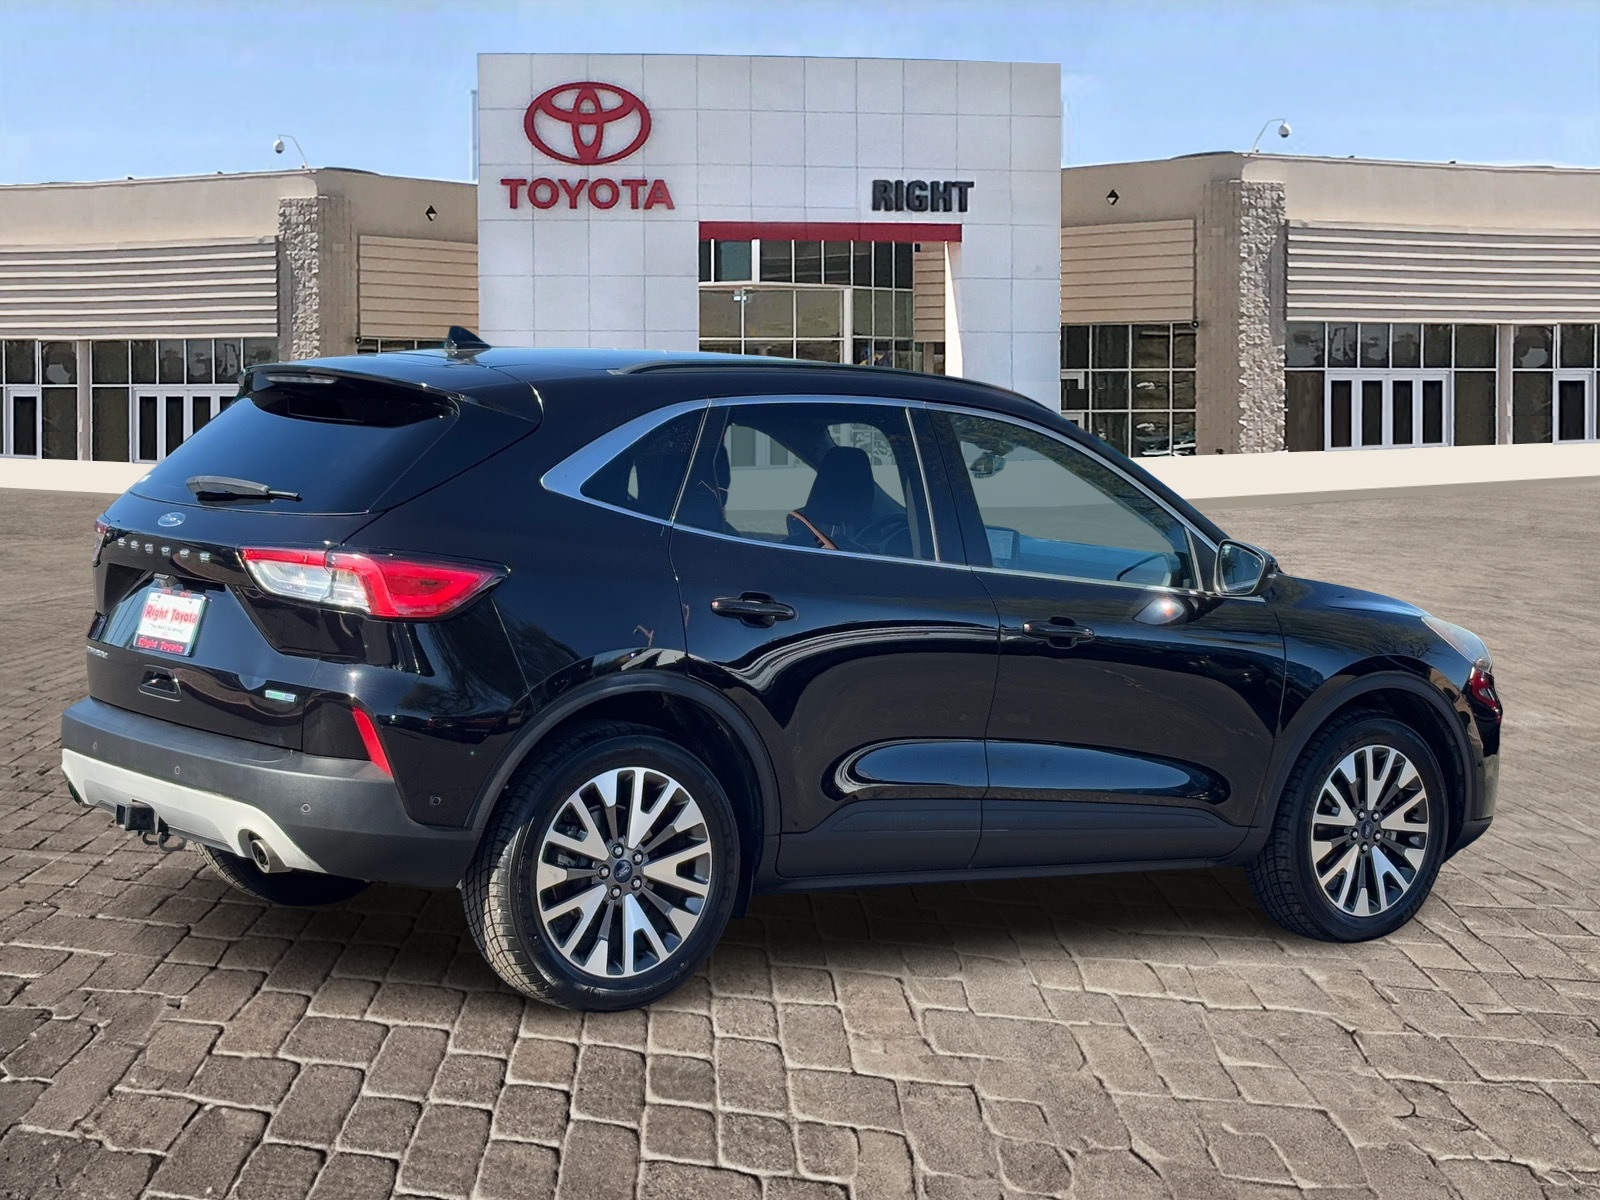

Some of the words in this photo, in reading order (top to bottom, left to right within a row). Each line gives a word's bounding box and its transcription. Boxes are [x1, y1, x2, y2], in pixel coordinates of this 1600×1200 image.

[500, 178, 675, 210] TOYOTA
[872, 179, 975, 213] RIGHT
[145, 604, 169, 620] Right
[171, 608, 198, 624] Toyota
